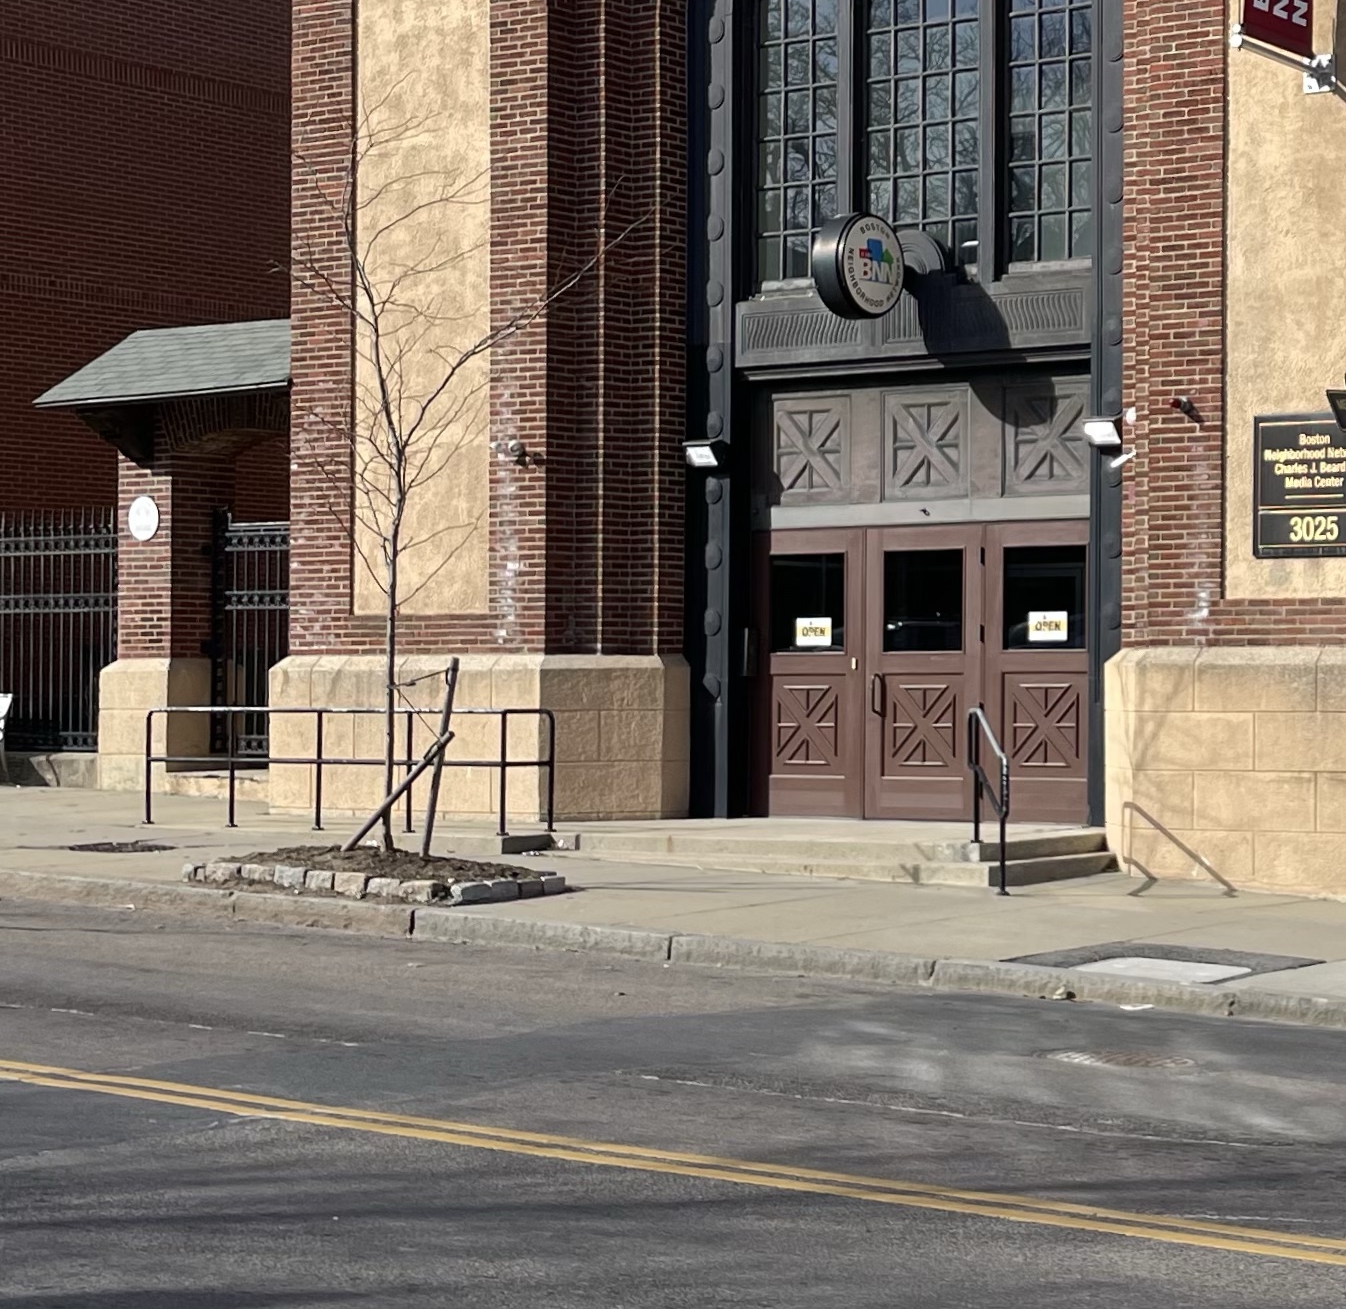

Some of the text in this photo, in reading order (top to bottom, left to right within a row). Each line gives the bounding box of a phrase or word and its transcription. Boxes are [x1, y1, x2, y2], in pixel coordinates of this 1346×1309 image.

[859, 222, 891, 239] BOSTON
[847, 247, 885, 308] NEIGHBORHOOD
[860, 258, 894, 285] BNN
[1299, 433, 1331, 446] Boston
[1264, 446, 1325, 462] Neighborhood
[1274, 462, 1308, 475] Charles
[1320, 461, 1345, 473] Beard
[1284, 475, 1344, 489] Media Center
[1289, 515, 1339, 542] 3025
[802, 626, 826, 637] OPEN
[1035, 621, 1062, 631] OPEN
